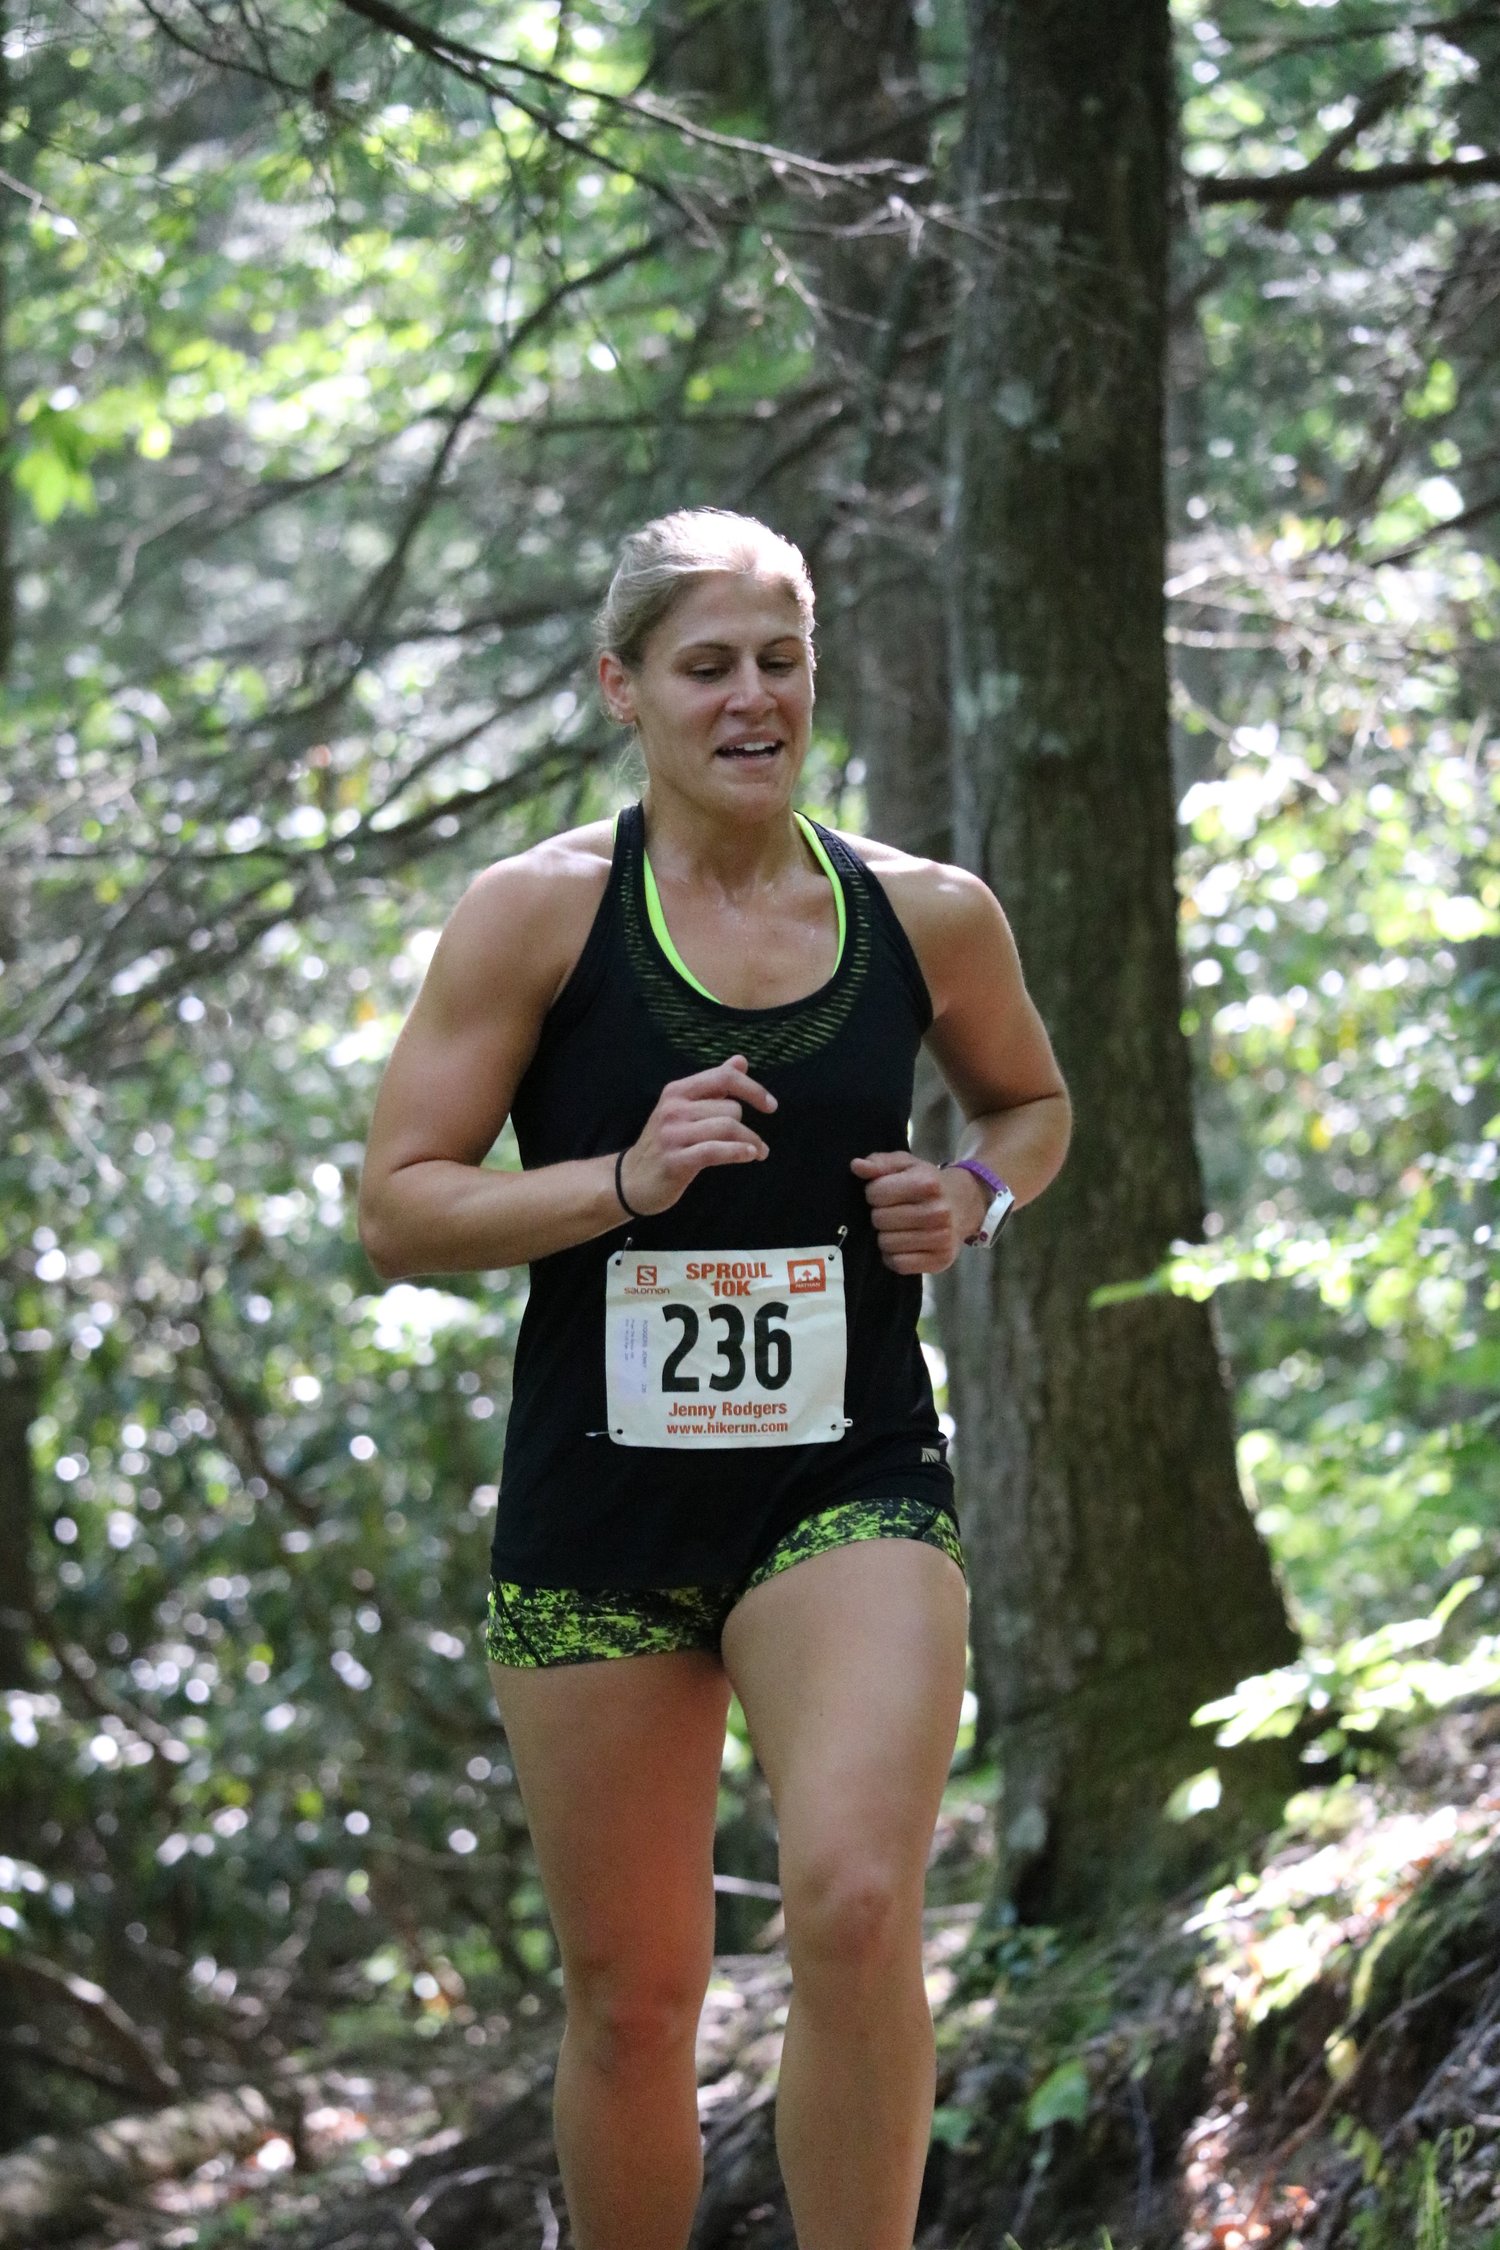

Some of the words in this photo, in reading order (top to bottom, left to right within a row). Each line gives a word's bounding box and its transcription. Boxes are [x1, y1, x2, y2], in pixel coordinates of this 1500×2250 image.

[686, 1262, 773, 1280] SPROUL
[711, 1280, 752, 1297] 10K
[661, 1301, 792, 1393] 236
[668, 1402, 717, 1419] Jenny
[722, 1402, 788, 1418] Rodgers
[666, 1422, 788, 1434] www.hikerun.com
